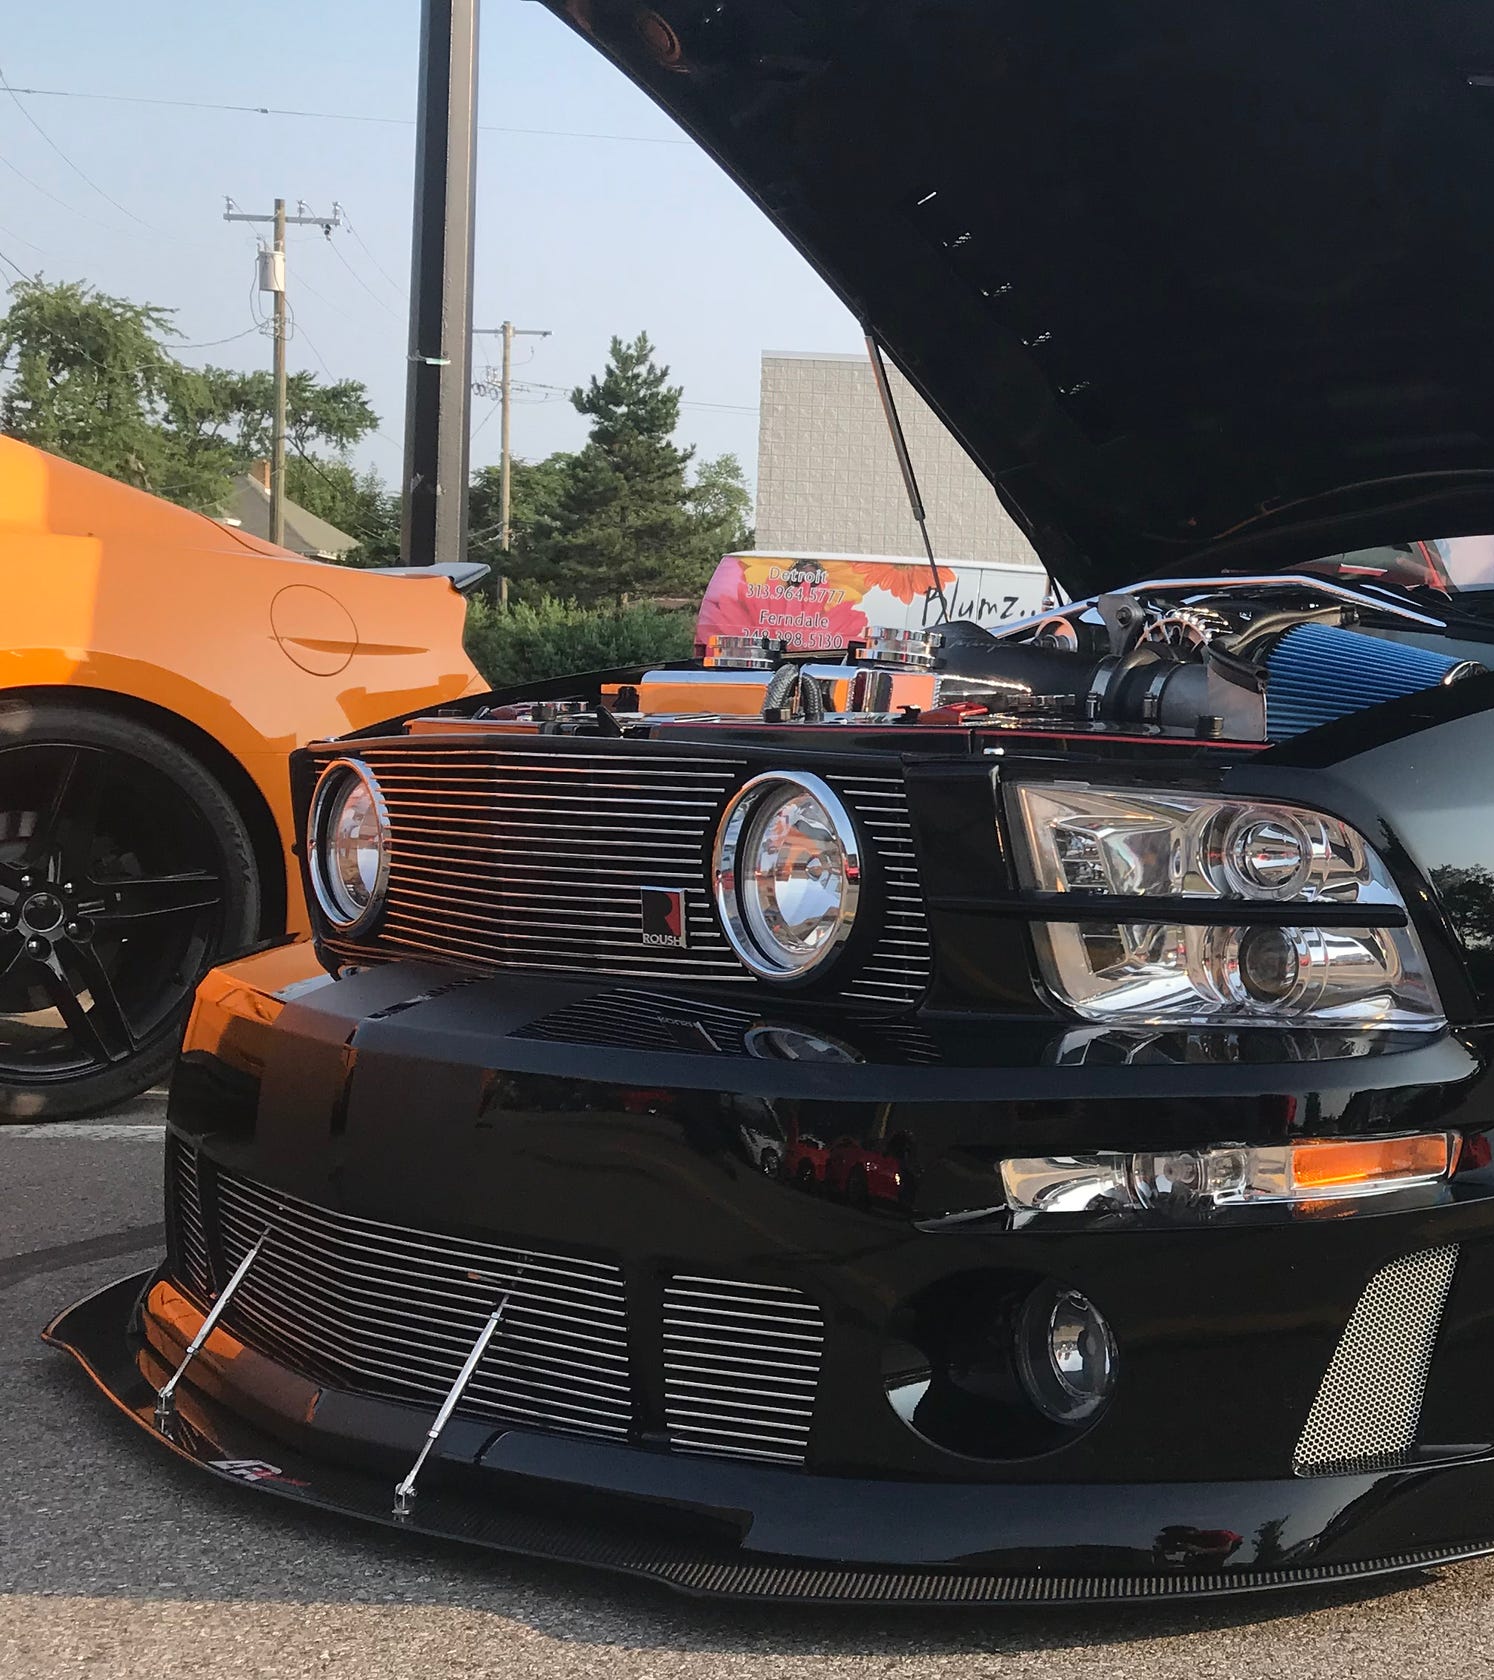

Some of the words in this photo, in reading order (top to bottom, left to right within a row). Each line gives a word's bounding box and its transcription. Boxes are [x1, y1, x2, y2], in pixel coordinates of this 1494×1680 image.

[769, 567, 828, 584] Detroit
[746, 583, 846, 604] 313.964.5777
[759, 609, 829, 628] Ferndale
[742, 628, 843, 649] 248398.5130
[643, 933, 681, 947] ROUSH
